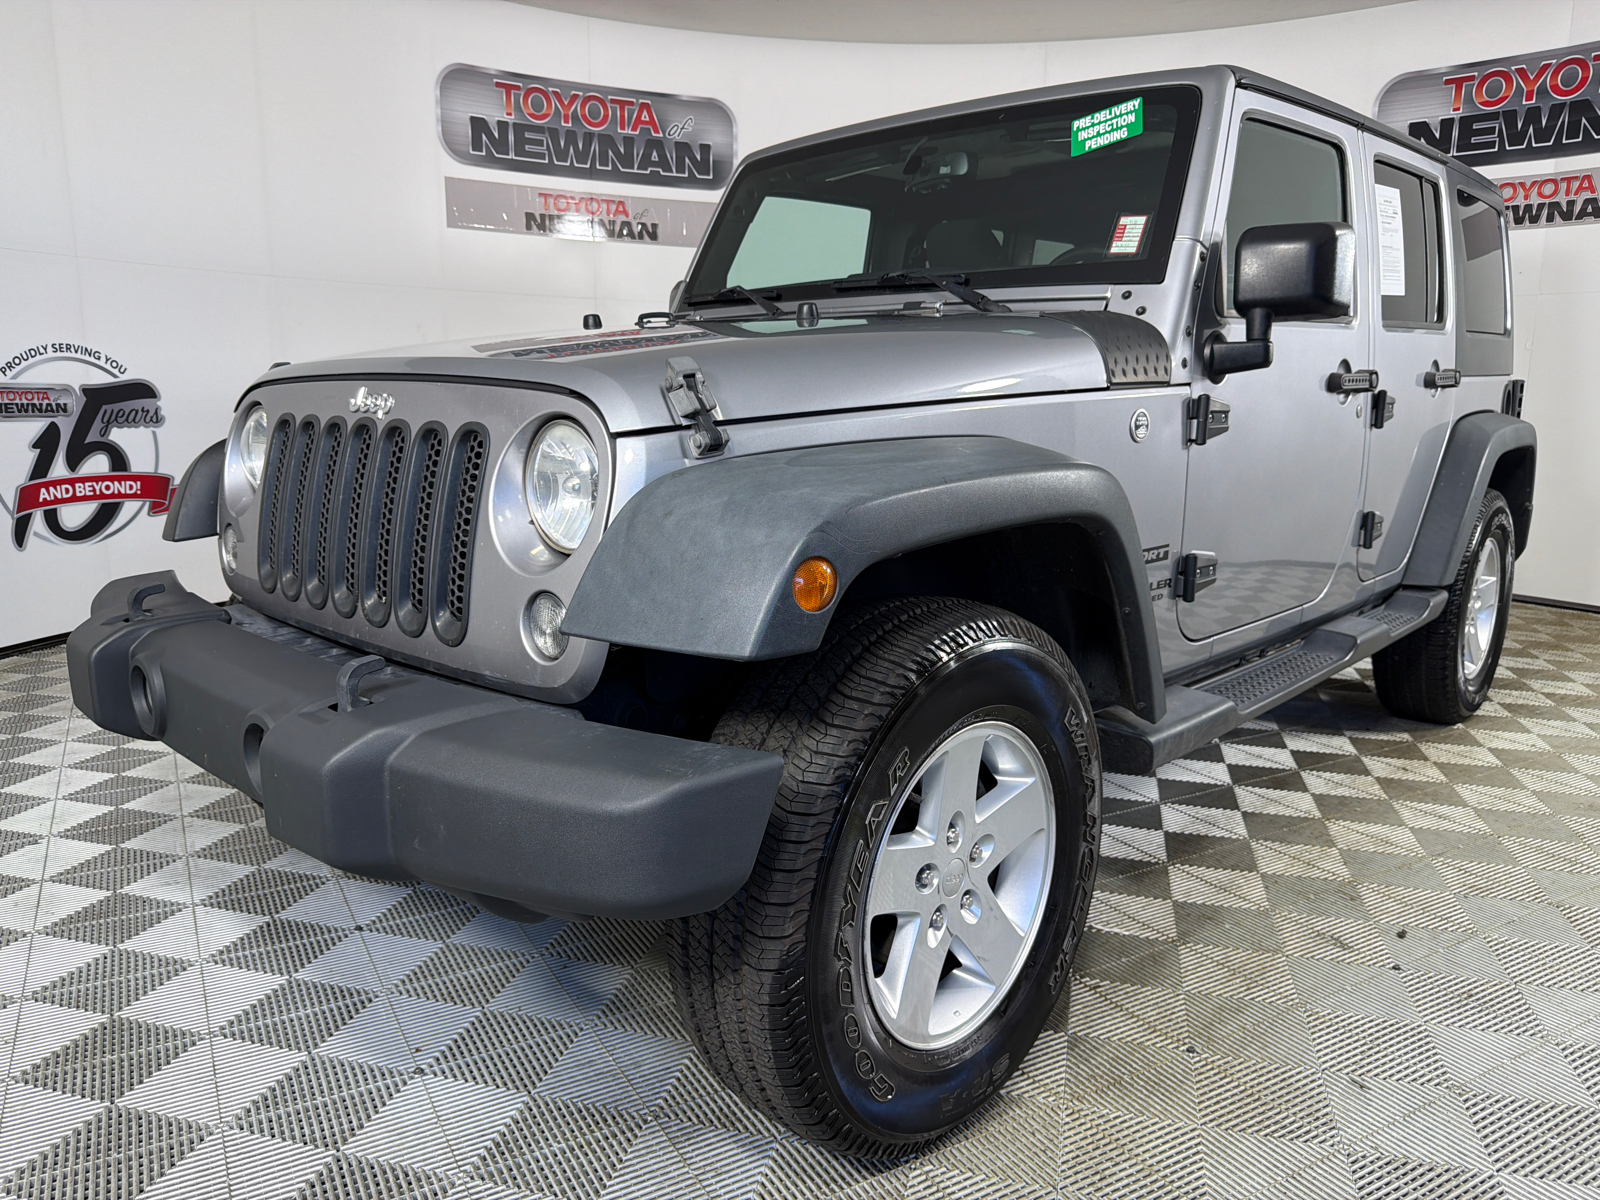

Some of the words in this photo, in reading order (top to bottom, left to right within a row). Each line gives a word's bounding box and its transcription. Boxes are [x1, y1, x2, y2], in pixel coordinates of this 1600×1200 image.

[1443, 53, 1600, 112] TOYO
[494, 80, 662, 136] TOYOTA
[667, 117, 694, 139] of
[1073, 98, 1140, 132] PRE-DELIVERY
[1078, 112, 1136, 141] INSPECTION
[469, 115, 714, 179] NEWNAN
[1085, 127, 1128, 151] PENDING
[538, 192, 629, 219] TOYOTA
[633, 208, 649, 221] of
[1505, 197, 1600, 226] WNA
[524, 211, 659, 241] NNAN
[0, 344, 48, 377] PROUDLY
[51, 343, 101, 361] SERVING
[104, 354, 127, 375] YOU
[0, 390, 51, 402] TOYOTA
[348, 386, 395, 420] Jeep
[14, 381, 158, 549] 15
[99, 405, 163, 438] years
[39, 485, 73, 502] AND
[75, 481, 141, 497] BEYOND!
[1049, 704, 1098, 996] WRANGLER
[835, 745, 910, 1102] GOODYEAR
